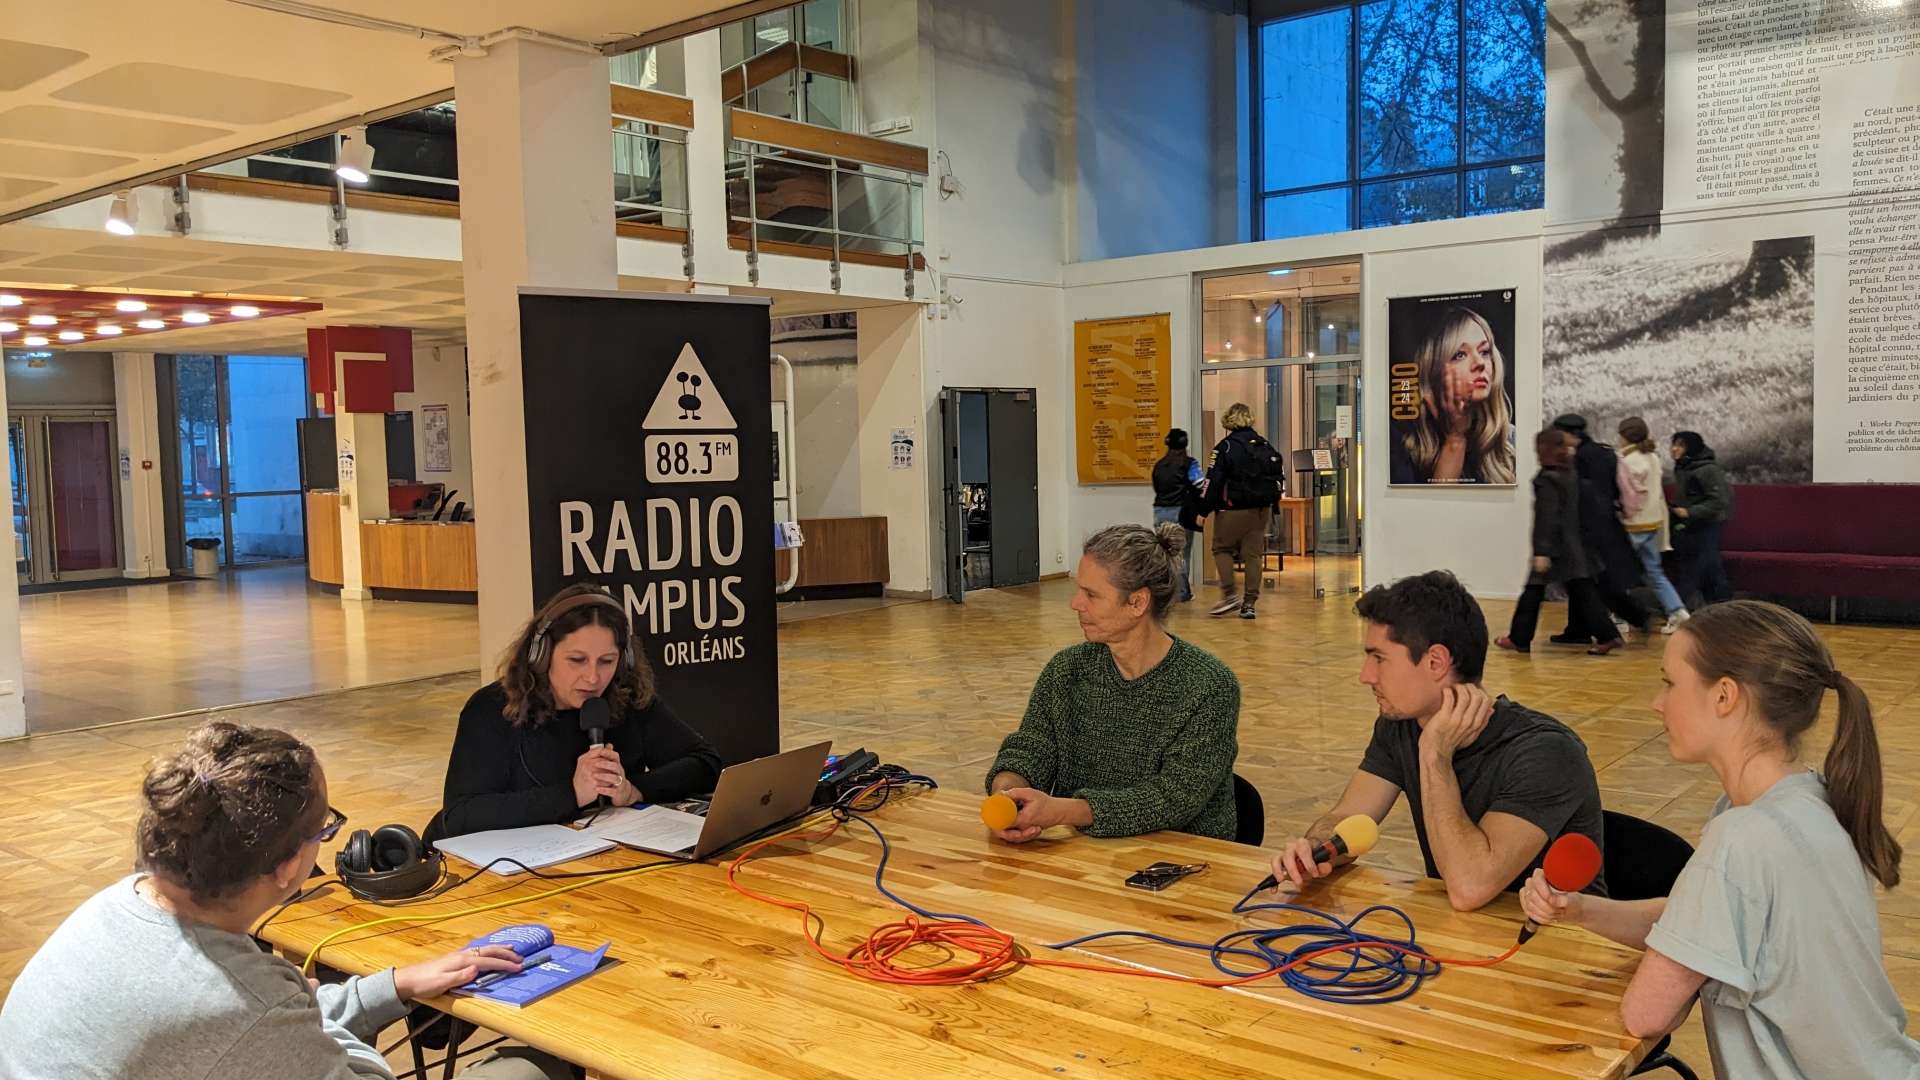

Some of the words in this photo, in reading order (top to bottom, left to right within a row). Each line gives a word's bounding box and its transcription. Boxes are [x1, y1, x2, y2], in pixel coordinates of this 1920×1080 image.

[1763, 4, 1799, 16] planches
[1726, 20, 1750, 30] C'était
[1754, 18, 1765, 26] un
[1767, 12, 1802, 24] modeste
[1698, 36, 1716, 44] avec
[1730, 28, 1752, 40] étage
[1698, 46, 1708, 54] ou
[1711, 42, 1736, 52] plutôt
[1740, 40, 1754, 48] par
[1776, 32, 1802, 42] lampe
[1698, 54, 1728, 63] montée
[1744, 45, 1776, 58] premier
[1698, 74, 1716, 84] pour
[1729, 68, 1754, 77] même
[1758, 64, 1784, 72] raison
[1785, 59, 1804, 70] qu'il
[1806, 55, 1836, 65] fumait
[1837, 52, 1854, 60] une
[1856, 48, 1875, 59] pipe
[1718, 59, 1748, 71] portait
[1768, 50, 1803, 61] chemise
[1710, 79, 1736, 89] s'était
[1740, 76, 1768, 86] jamais
[1772, 68, 1804, 80] habitué
[1698, 87, 1748, 100] s'habituerait
[1781, 76, 1820, 88] alternant
[1712, 97, 1739, 107] clients
[1742, 94, 1753, 102] lui
[1756, 89, 1792, 100] offraient
[1718, 106, 1745, 116] fumait
[1748, 101, 1768, 111] alors
[1770, 100, 1782, 108] les
[1784, 96, 1804, 106] trois
[1864, 106, 1894, 116] C'était
[1728, 114, 1745, 124] bien
[1747, 110, 1765, 122] qu'il
[1712, 126, 1729, 135] côté
[1742, 121, 1760, 130] d'un
[1790, 116, 1810, 124] avec
[1697, 136, 1716, 146] dans
[1730, 133, 1754, 144] petite
[1758, 128, 1774, 137] ville
[1787, 125, 1814, 135] quatre
[1854, 126, 1901, 140] précédent,
[1696, 143, 1744, 155] maintenant
[1746, 134, 1803, 150] quarante-huit
[1853, 138, 1896, 148] sculpteur
[1735, 150, 1753, 160] puis
[1756, 148, 1778, 158] vingt
[1780, 146, 1796, 154] ans
[1853, 150, 1864, 158] de
[1866, 147, 1899, 156] cuisine
[1896, 152, 1918, 162] dit-il
[1696, 164, 1719, 172] disait
[1752, 155, 1785, 168] croyait)
[1787, 154, 1803, 162] que
[1806, 152, 1816, 160] les
[1696, 173, 1720, 182] c'était
[1723, 170, 1736, 178] fait
[1739, 168, 1758, 178] pour
[1760, 166, 1772, 174] les
[1774, 162, 1806, 174] gandins
[1853, 169, 1872, 177] sont
[1878, 166, 1904, 174] avant
[1714, 180, 1732, 189] était
[1735, 177, 1762, 186] minuit
[1793, 172, 1812, 180] mais
[1853, 178, 1890, 187] femmes.
[1717, 190, 1736, 198] tenir
[1738, 186, 1769, 196] compte
[1772, 184, 1783, 192] du
[1809, 180, 1820, 188] du
[1848, 216, 1874, 226] voulu
[1877, 214, 1918, 223] échanger
[1848, 227, 1864, 236] elle
[1866, 225, 1896, 234] n'avait
[1849, 238, 1875, 248] pensa
[1848, 246, 1898, 256] cramponne
[1860, 256, 1886, 265] refuse
[1848, 266, 1886, 277] parvient
[1889, 266, 1905, 274] pas
[1885, 274, 1906, 282] Rien
[1860, 284, 1898, 294] Pendant
[1902, 283, 1914, 291] les
[1848, 296, 1864, 304] des
[1868, 294, 1910, 304] hôpitaux,
[1848, 306, 1880, 314] service
[1848, 316, 1880, 324] étaient
[1848, 326, 1870, 334] avait
[1874, 324, 1910, 333] quelque
[1848, 334, 1872, 344] école
[1876, 334, 1886, 342] de
[1848, 344, 1880, 354] hôpital
[1882, 344, 1914, 352] connu,
[1848, 356, 1878, 364] quatre
[1860, 365, 1877, 374] que
[1858, 374, 1906, 384] cinquième
[1864, 383, 1888, 392] soleil
[1892, 382, 1914, 390] dans
[1401, 393, 1410, 404] 24
[1848, 394, 1892, 404] jardiniers
[1896, 392, 1908, 400] du
[1848, 445, 1882, 453] problème
[656, 442, 712, 475] 88.3
[716, 442, 732, 456] FM
[560, 496, 743, 576] RADIO
[601, 576, 746, 635] MPUS
[664, 634, 745, 666] ORLÉANS
